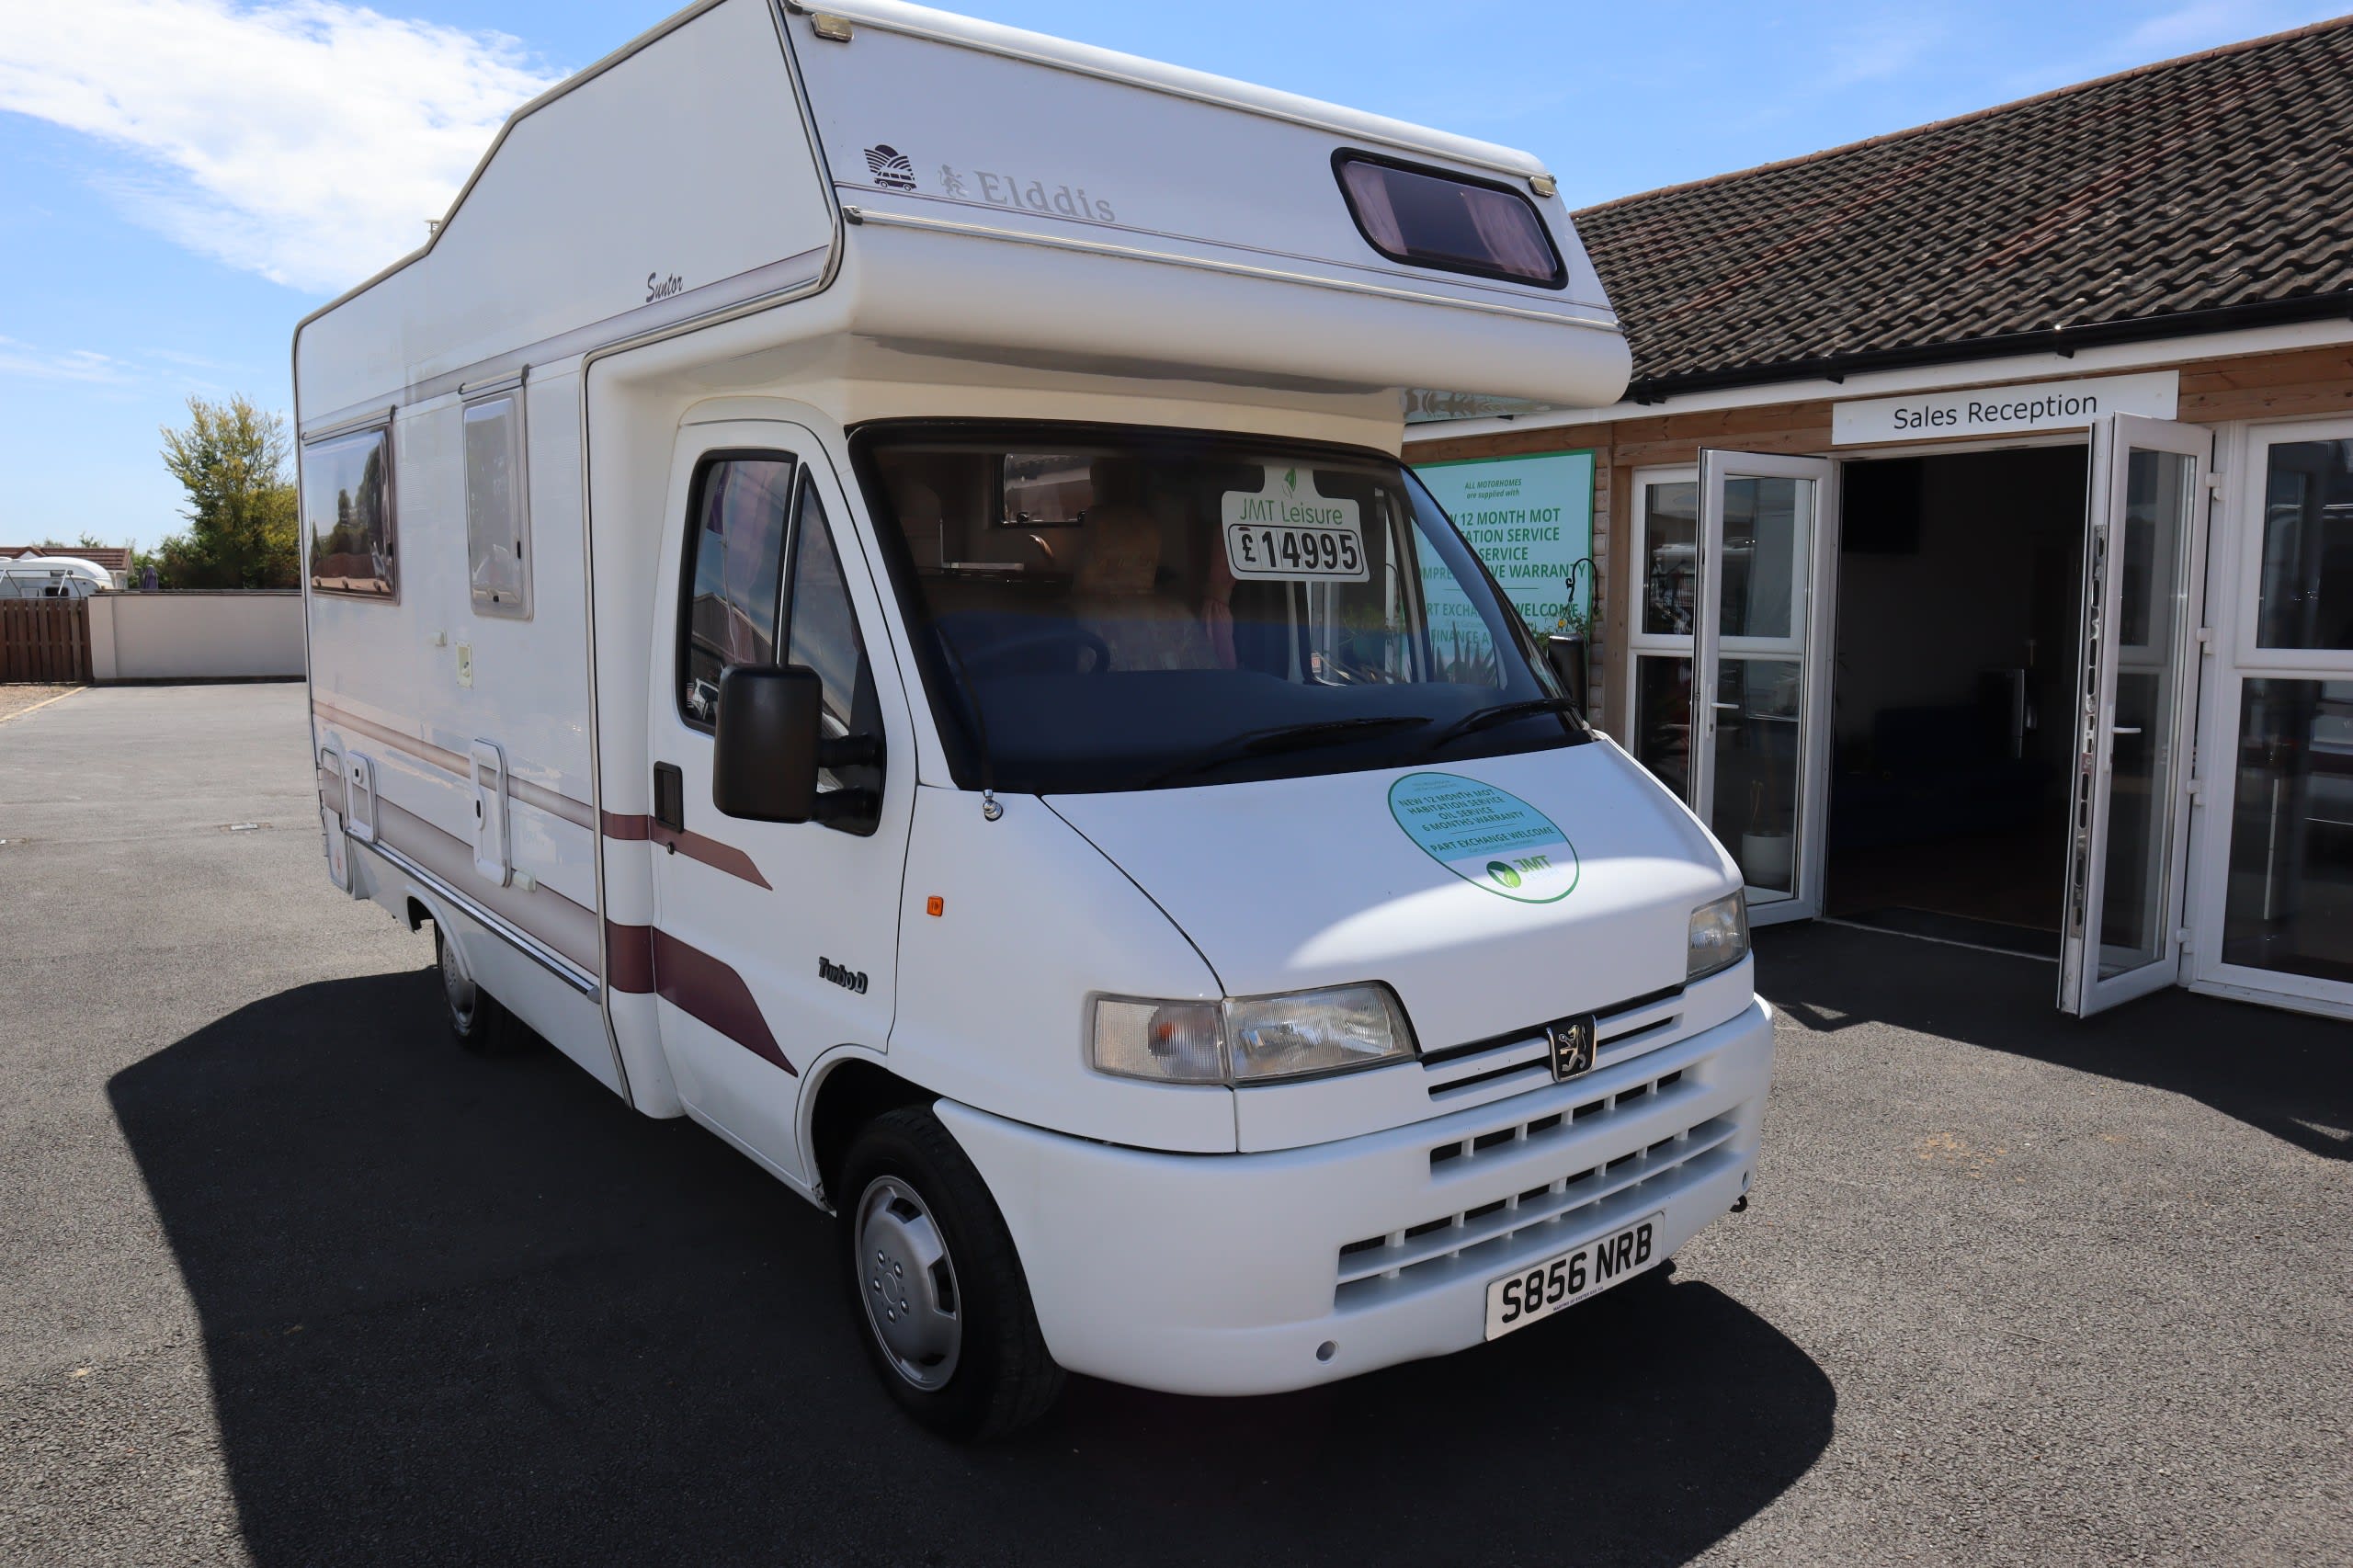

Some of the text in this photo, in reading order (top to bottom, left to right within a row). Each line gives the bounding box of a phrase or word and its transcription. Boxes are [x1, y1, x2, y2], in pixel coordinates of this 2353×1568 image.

[973, 170, 1116, 222] Elddis
[1893, 394, 2097, 430] Sales Reception
[1464, 478, 1522, 490] ALL MOTORHOMES
[1478, 490, 1505, 500] supplied
[1506, 488, 1520, 497] with
[1239, 498, 1344, 526] JMT Leisure
[1461, 512, 1473, 527] 12
[1477, 509, 1526, 526] MONTH
[1529, 507, 1561, 524] MOT
[1461, 527, 1560, 544] ATION SERVICE
[1241, 530, 1358, 570] £14995
[1397, 789, 1495, 807] NEW 12 MONTH MOT
[1407, 796, 1506, 815] HABITATION SERVICE
[1430, 818, 1474, 831] MONTHS
[1473, 811, 1525, 824] WARRANTY
[1438, 806, 1496, 820] OIL SERVICE
[1430, 841, 1457, 852] PART
[1457, 834, 1510, 848] EXCHANGE
[1507, 827, 1555, 839] WELCOME
[1512, 855, 1552, 873] JMT
[1501, 1222, 1653, 1324] S856 NRB
